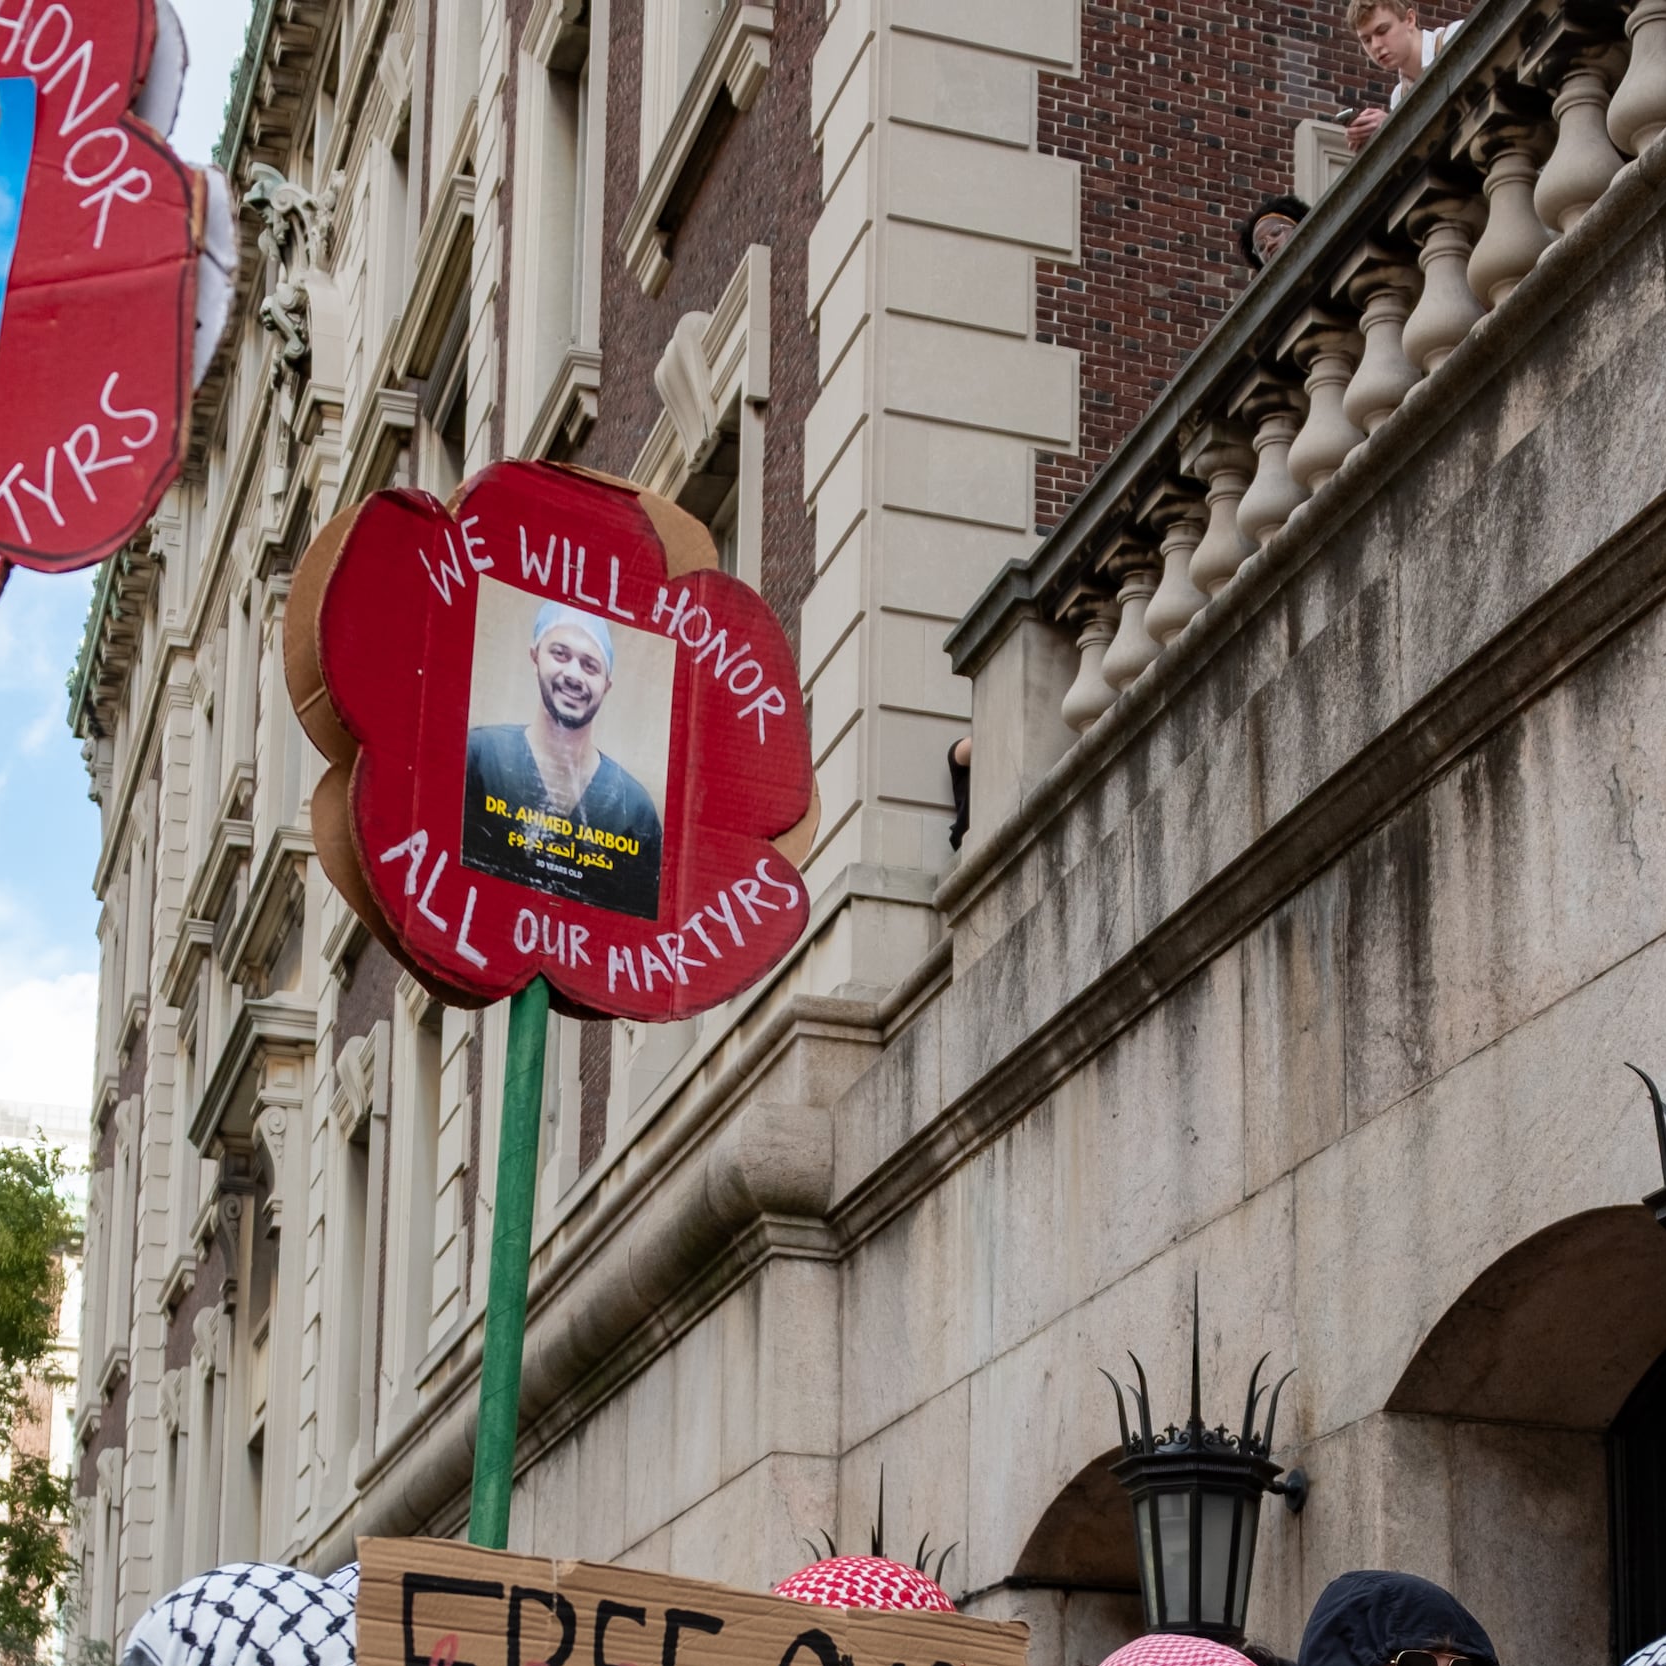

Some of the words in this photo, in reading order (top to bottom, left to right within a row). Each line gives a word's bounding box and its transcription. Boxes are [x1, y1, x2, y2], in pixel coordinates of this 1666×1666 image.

[419, 516, 495, 606] WE
[519, 524, 635, 621] WILL
[651, 586, 787, 745] HONOR
[485, 795, 513, 818] DR.
[515, 806, 573, 836] AHMED
[575, 825, 640, 856] JARBOU
[568, 868, 583, 879] OLD
[379, 828, 490, 970] ALL
[514, 908, 592, 969] OUR
[607, 858, 800, 994] MARTYRS
